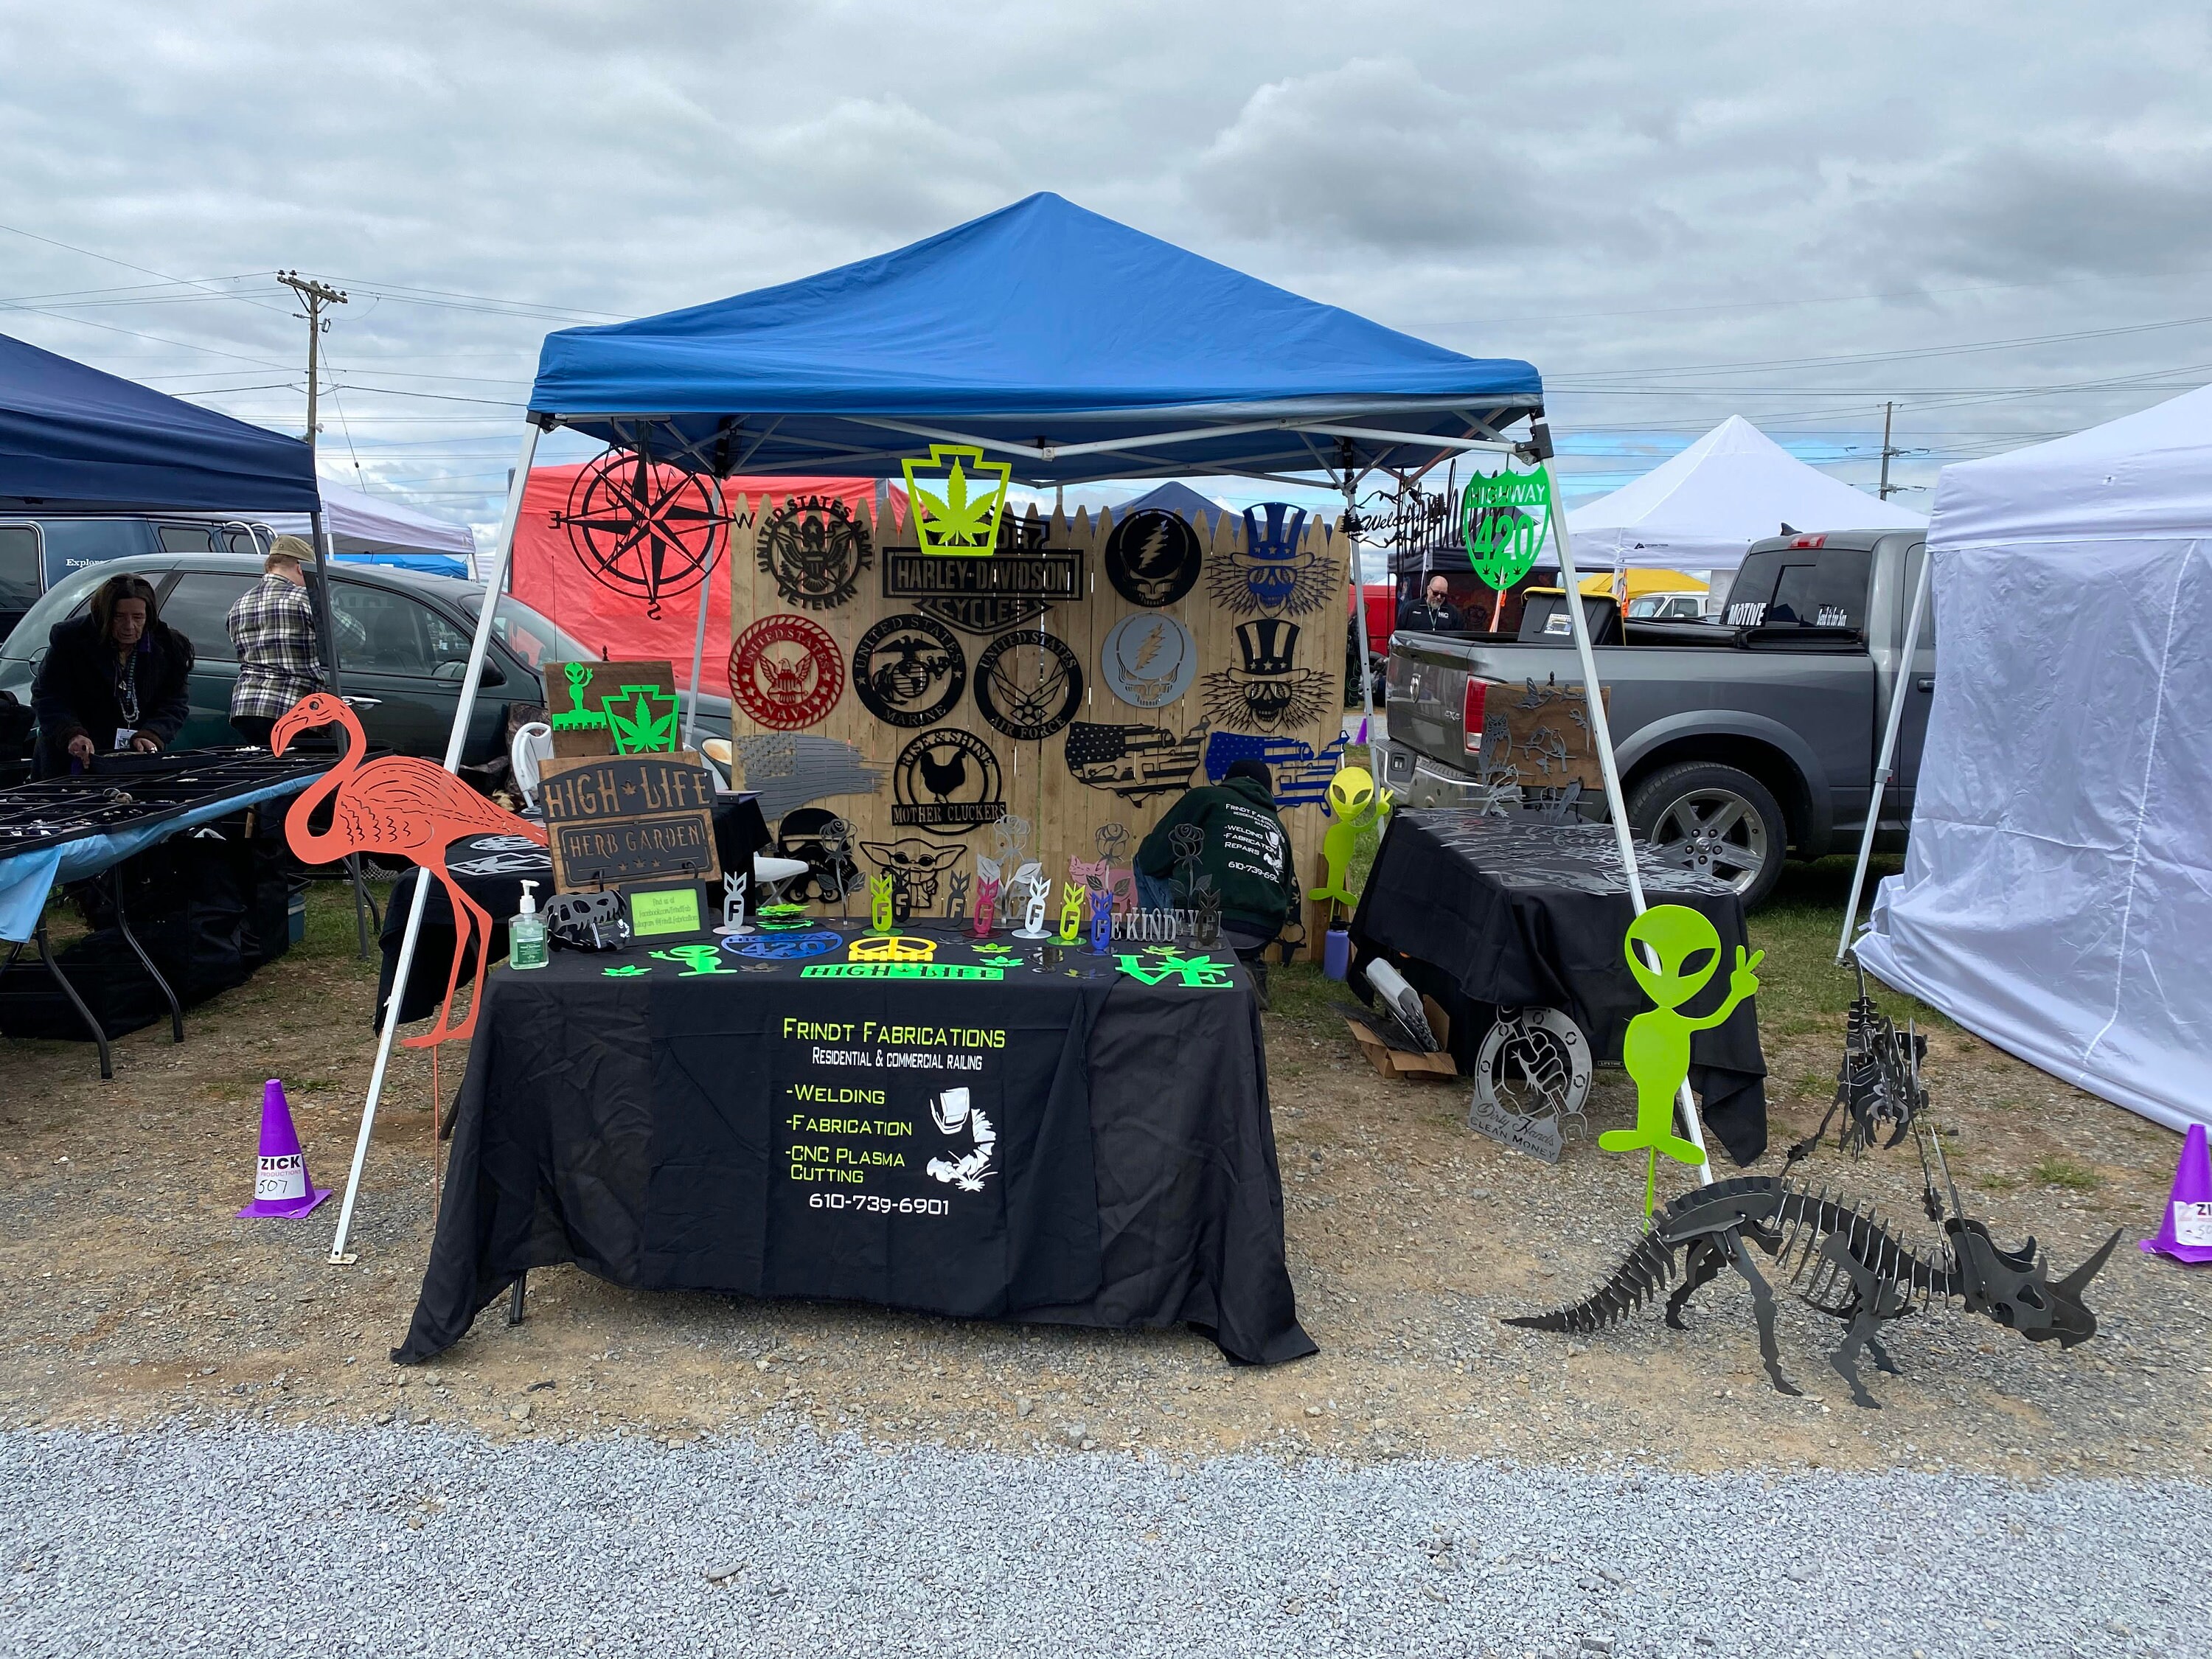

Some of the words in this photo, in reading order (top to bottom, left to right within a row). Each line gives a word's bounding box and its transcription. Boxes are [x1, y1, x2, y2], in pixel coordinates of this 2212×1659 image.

[1470, 483, 1546, 505] HIGHWAY
[757, 507, 785, 573] UNITED
[787, 495, 852, 519] STATES
[850, 520, 873, 571] ARMY
[1475, 514, 1534, 560] 420
[66, 558, 103, 568] Explor
[897, 560, 1069, 591] HARLEY-DAVIDSON
[778, 585, 858, 611] VETERAN
[936, 599, 1028, 627] CYCLES
[1728, 603, 1767, 625] MOTIVE
[742, 629, 784, 668] UNITED
[787, 629, 829, 668] STATES
[855, 617, 903, 669] UNITED
[911, 617, 962, 664] STATES
[979, 633, 1027, 668] UNITED
[1031, 632, 1077, 668] STATES
[763, 703, 813, 720] NAVY
[883, 705, 946, 724] MARINE
[992, 717, 1015, 735] AIR
[1020, 716, 1066, 739] FORCE
[902, 736, 931, 765] RISE
[950, 731, 993, 767] SHINE
[544, 768, 621, 818] HIGH
[639, 766, 711, 809] LIFE
[894, 807, 942, 823] MOTHER
[947, 804, 1005, 821] CLUCKERS
[568, 834, 618, 859] HERB
[626, 824, 700, 852] GARDEN
[1224, 825, 1263, 839] -WELDING
[1223, 833, 1276, 855] -FABRICATION
[1225, 842, 1260, 855] REPAIRS
[728, 900, 742, 922] F
[877, 902, 888, 925] F
[950, 898, 963, 919] F
[1032, 905, 1043, 925] F
[1066, 911, 1078, 935] F
[1126, 913, 1177, 942] KIND
[741, 941, 827, 956] 420
[810, 965, 891, 977] HIGH
[919, 966, 998, 978] LIFE
[783, 1018, 855, 1043] FRINDT
[863, 1022, 1006, 1048] FABRICATIONS
[813, 1046, 872, 1067] RESIDENTIAL
[875, 1051, 883, 1067] &
[886, 1052, 943, 1069] COMMERCIAL
[947, 1054, 982, 1071] RAILING
[786, 1084, 885, 1105] -WELDING
[786, 1115, 912, 1136] -FABRICATION
[1476, 1102, 1510, 1129] Dirty
[1512, 1116, 1554, 1147] Hands
[1470, 1116, 1508, 1138] CLEAN
[1512, 1134, 1556, 1158] MONEY
[261, 1156, 300, 1170] ZICK
[785, 1145, 829, 1163] -CNC
[836, 1148, 905, 1167] PLASMA
[260, 1169, 302, 1178] PRODUCTIONS
[790, 1164, 864, 1183] CUTTING
[258, 1180, 288, 1194] 507
[810, 1193, 949, 1215] 610-739-6901
[2197, 1204, 2212, 1216] ZI
[2199, 1225, 2212, 1236] 50
